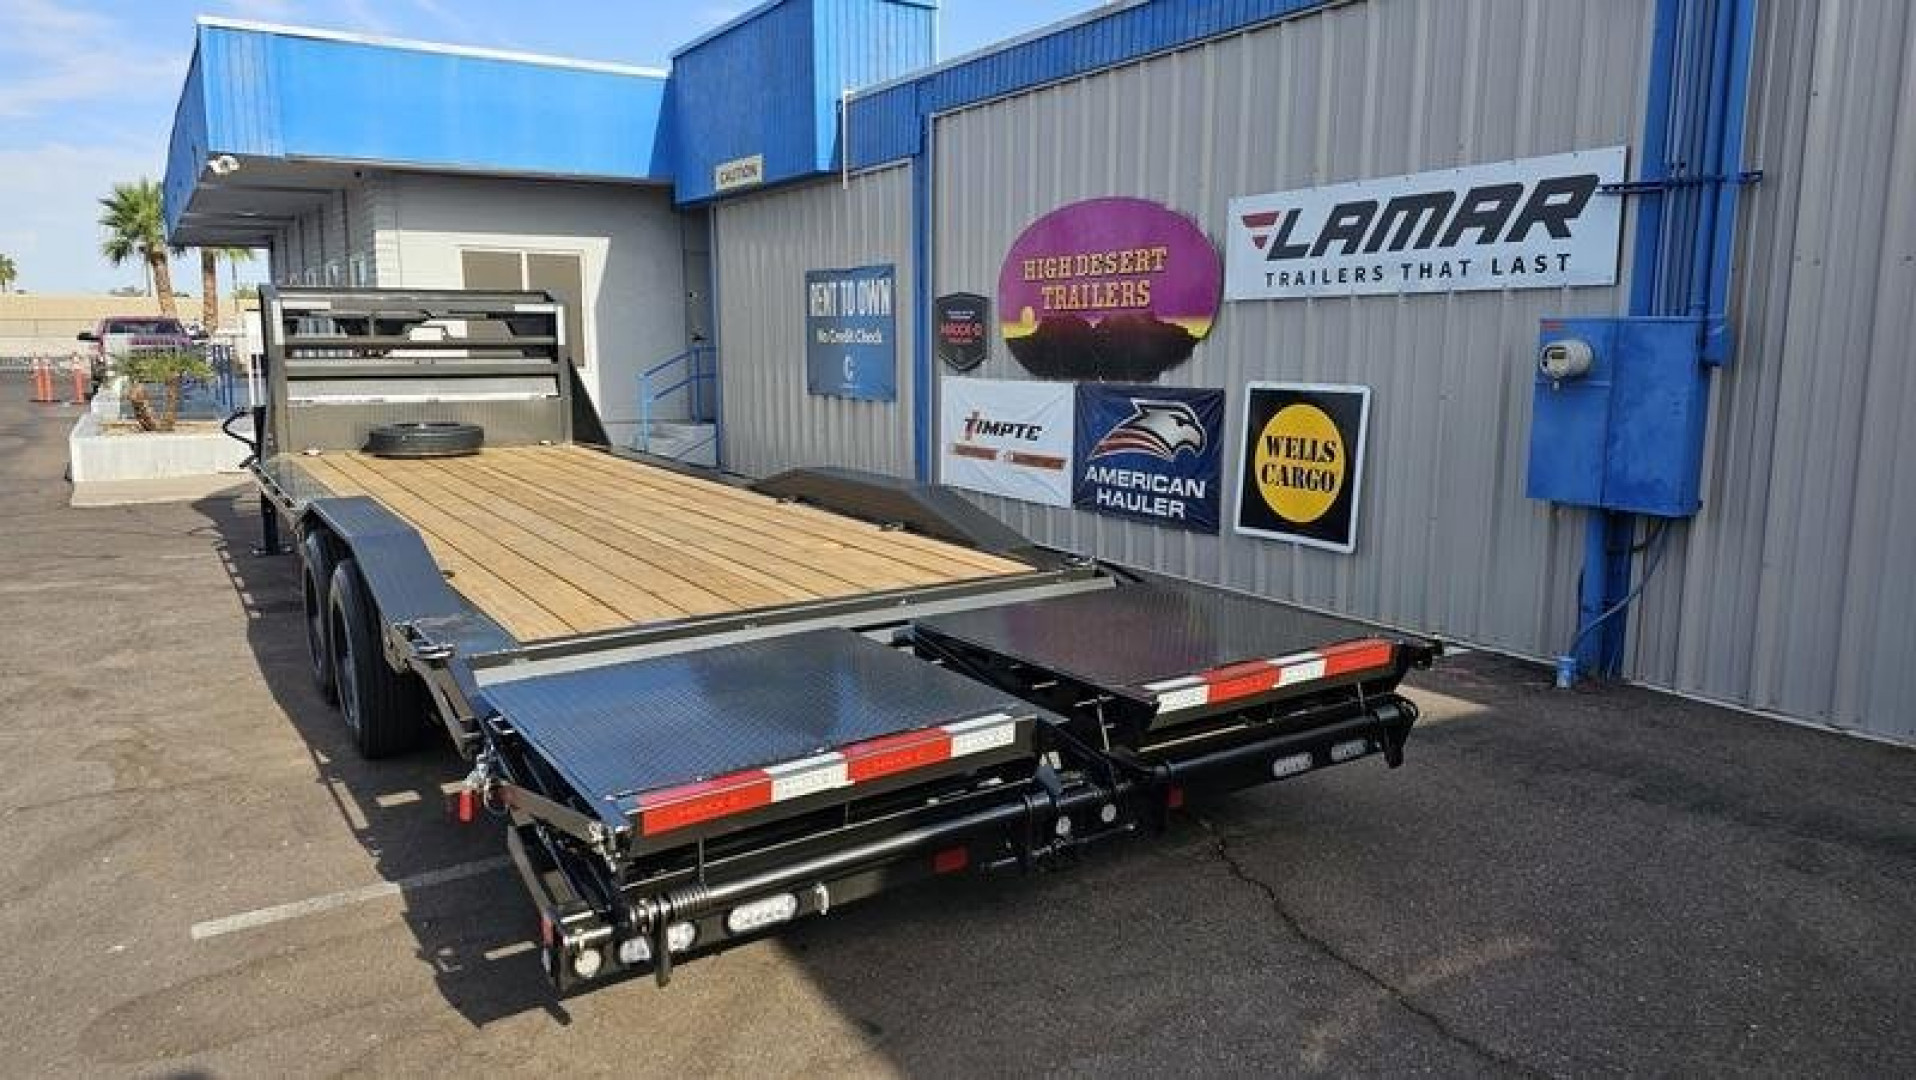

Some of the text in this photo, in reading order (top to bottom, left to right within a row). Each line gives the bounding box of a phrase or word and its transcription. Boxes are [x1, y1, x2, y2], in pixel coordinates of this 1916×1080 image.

[1266, 174, 1600, 262] LAMAR
[1023, 246, 1168, 280] HIGH DESERT
[1265, 253, 1572, 287] TRAILERS THAT LAST
[810, 279, 892, 317] RENT TO OWN
[1041, 279, 1151, 310] TRAILERS
[1266, 435, 1337, 463] WELLS
[1084, 465, 1206, 499] AMERICAN
[1261, 462, 1336, 494] CARGO
[1096, 487, 1185, 518] HAULER
